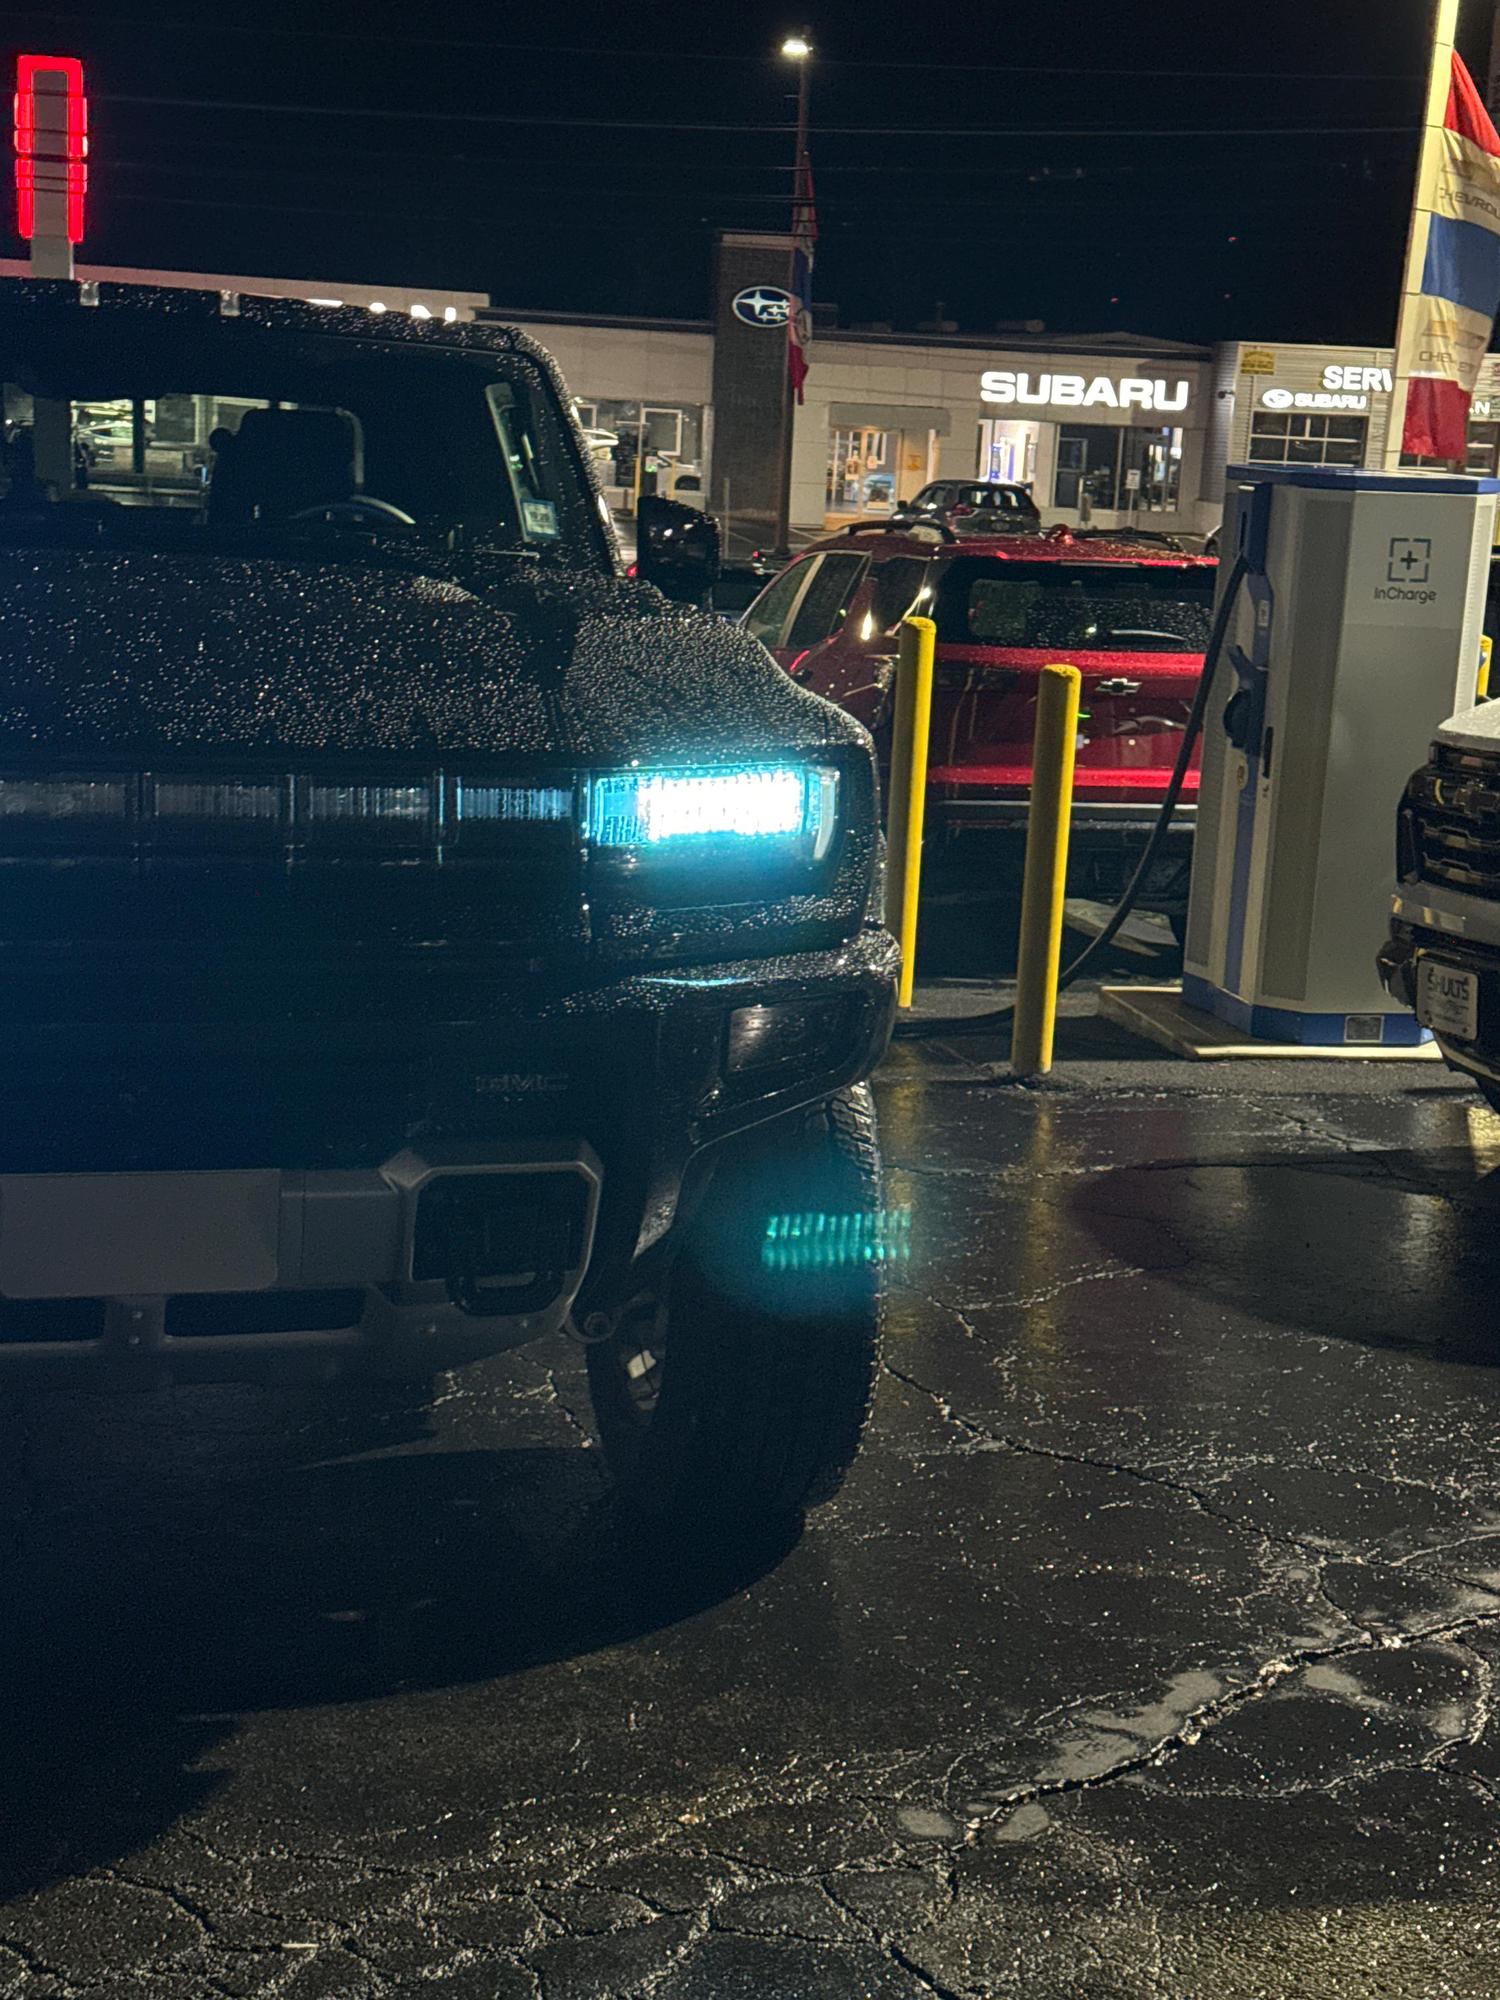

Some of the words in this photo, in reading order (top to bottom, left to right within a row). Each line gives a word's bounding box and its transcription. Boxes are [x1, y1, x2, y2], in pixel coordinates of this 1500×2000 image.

[980, 371, 1189, 411] SUBARU
[1294, 392, 1367, 409] SUBARU
[1374, 586, 1437, 605] InCharge
